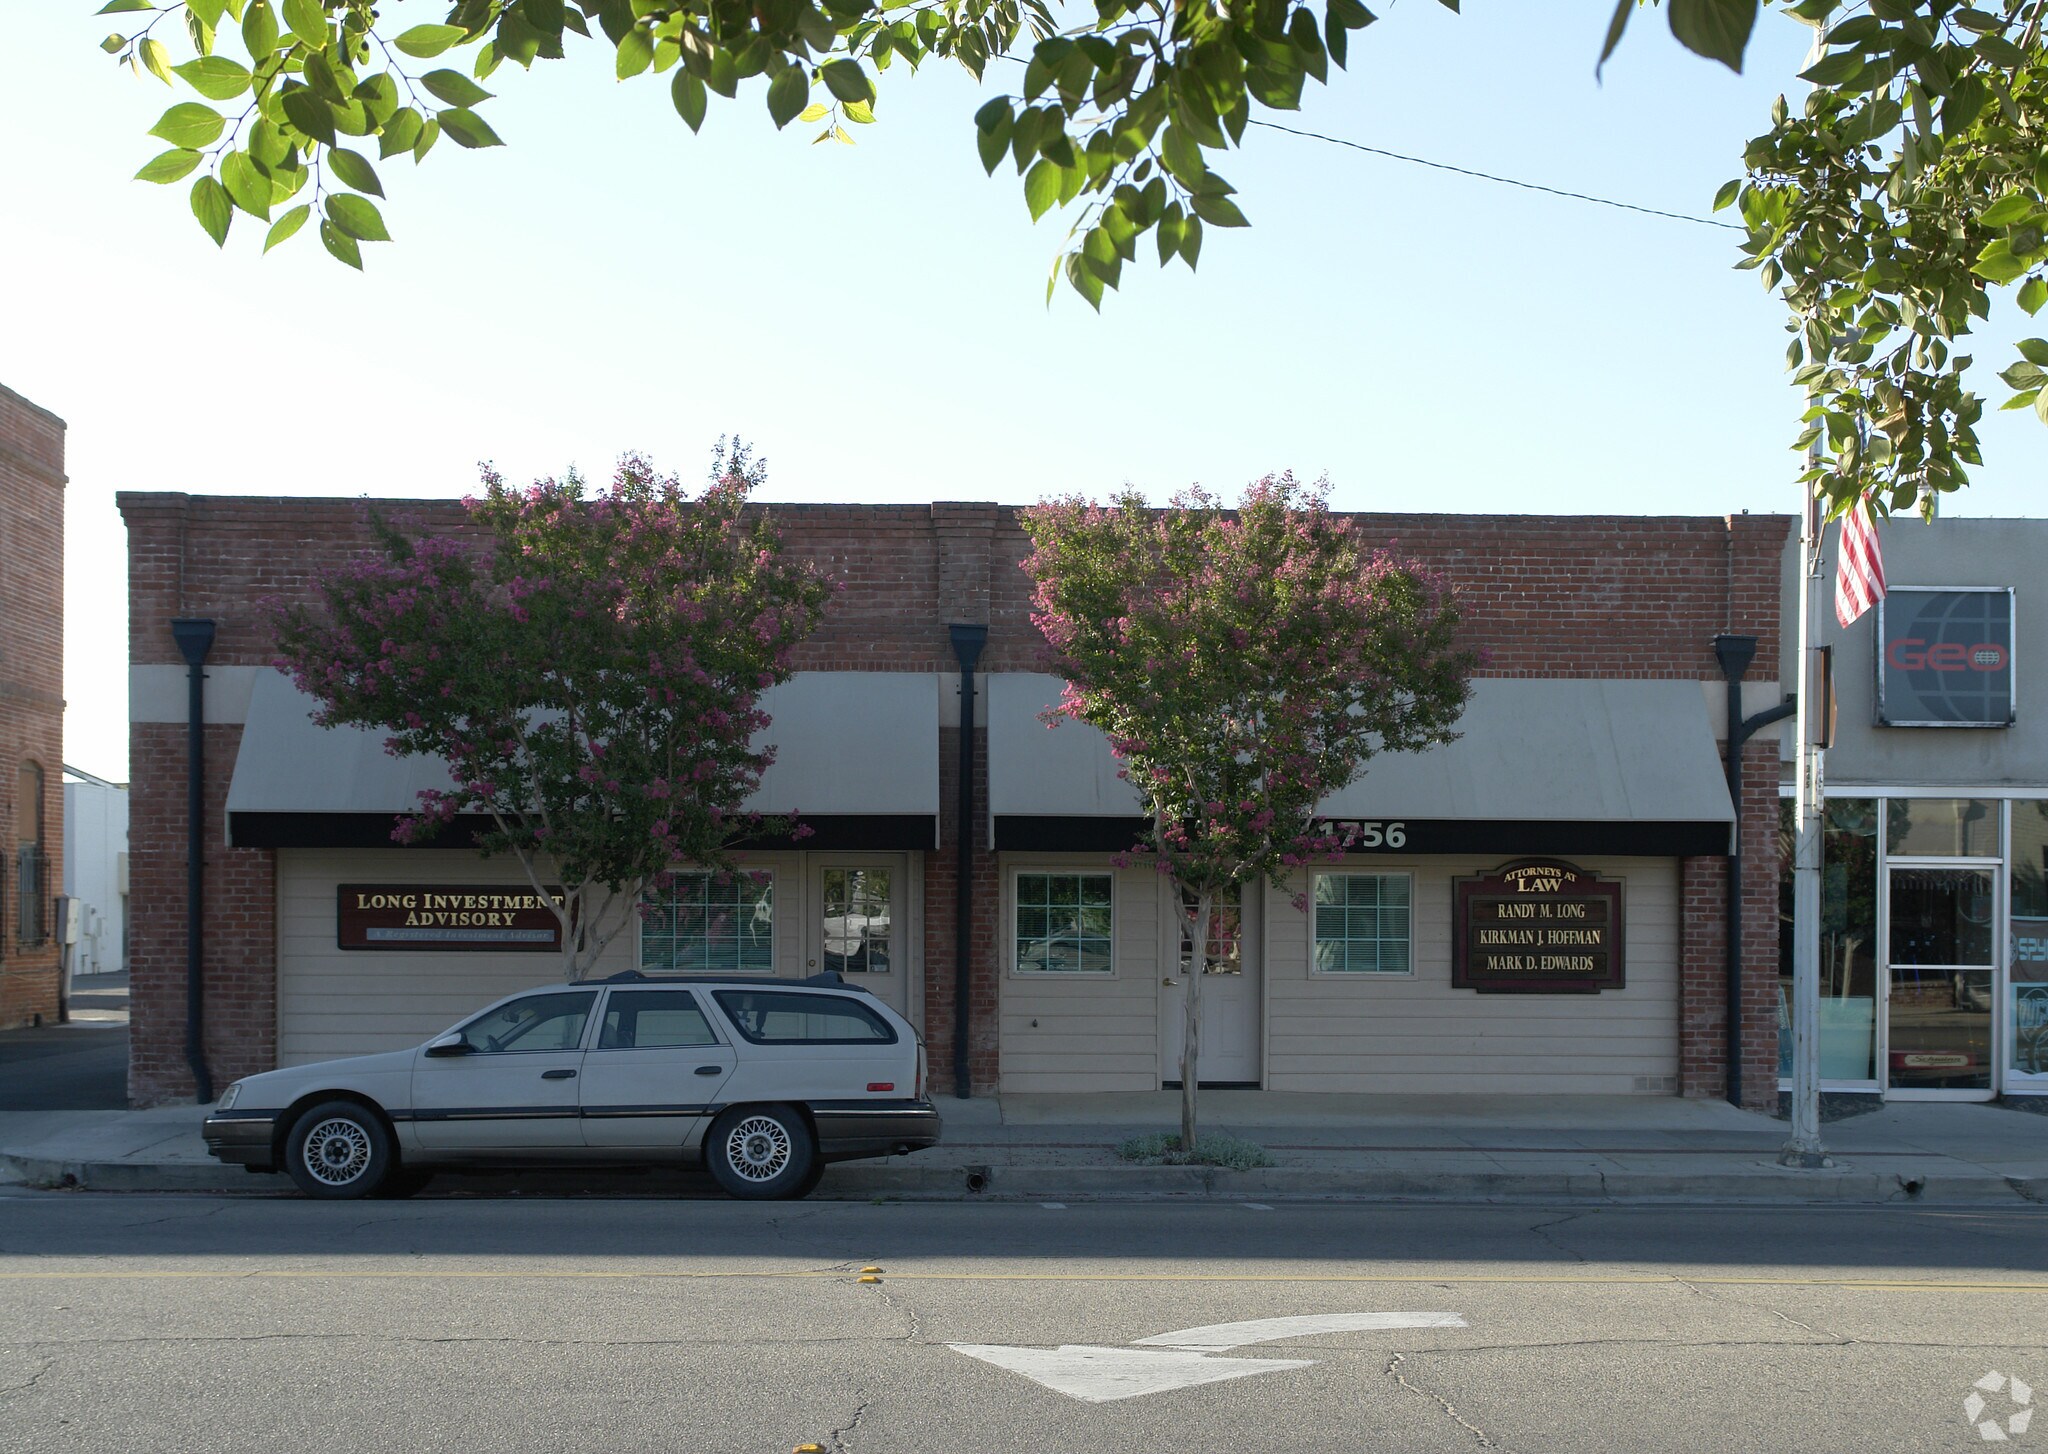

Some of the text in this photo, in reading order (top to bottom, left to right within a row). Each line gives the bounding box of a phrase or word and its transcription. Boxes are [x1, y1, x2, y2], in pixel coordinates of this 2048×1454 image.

[1886, 639, 2008, 671] Geo
[1503, 867, 1577, 883] ATTORNEYS AT
[1517, 878, 1563, 892] LAW
[357, 893, 564, 910] LONG INVESTMENT
[405, 911, 516, 926] ADVISORY
[1498, 904, 1585, 918] RANDY M. LONG
[1480, 930, 1601, 946] KIRKMAN J. HOFFMAN
[2019, 937, 2048, 961] SPY
[1487, 956, 1594, 970] MARK D. EDWARDS
